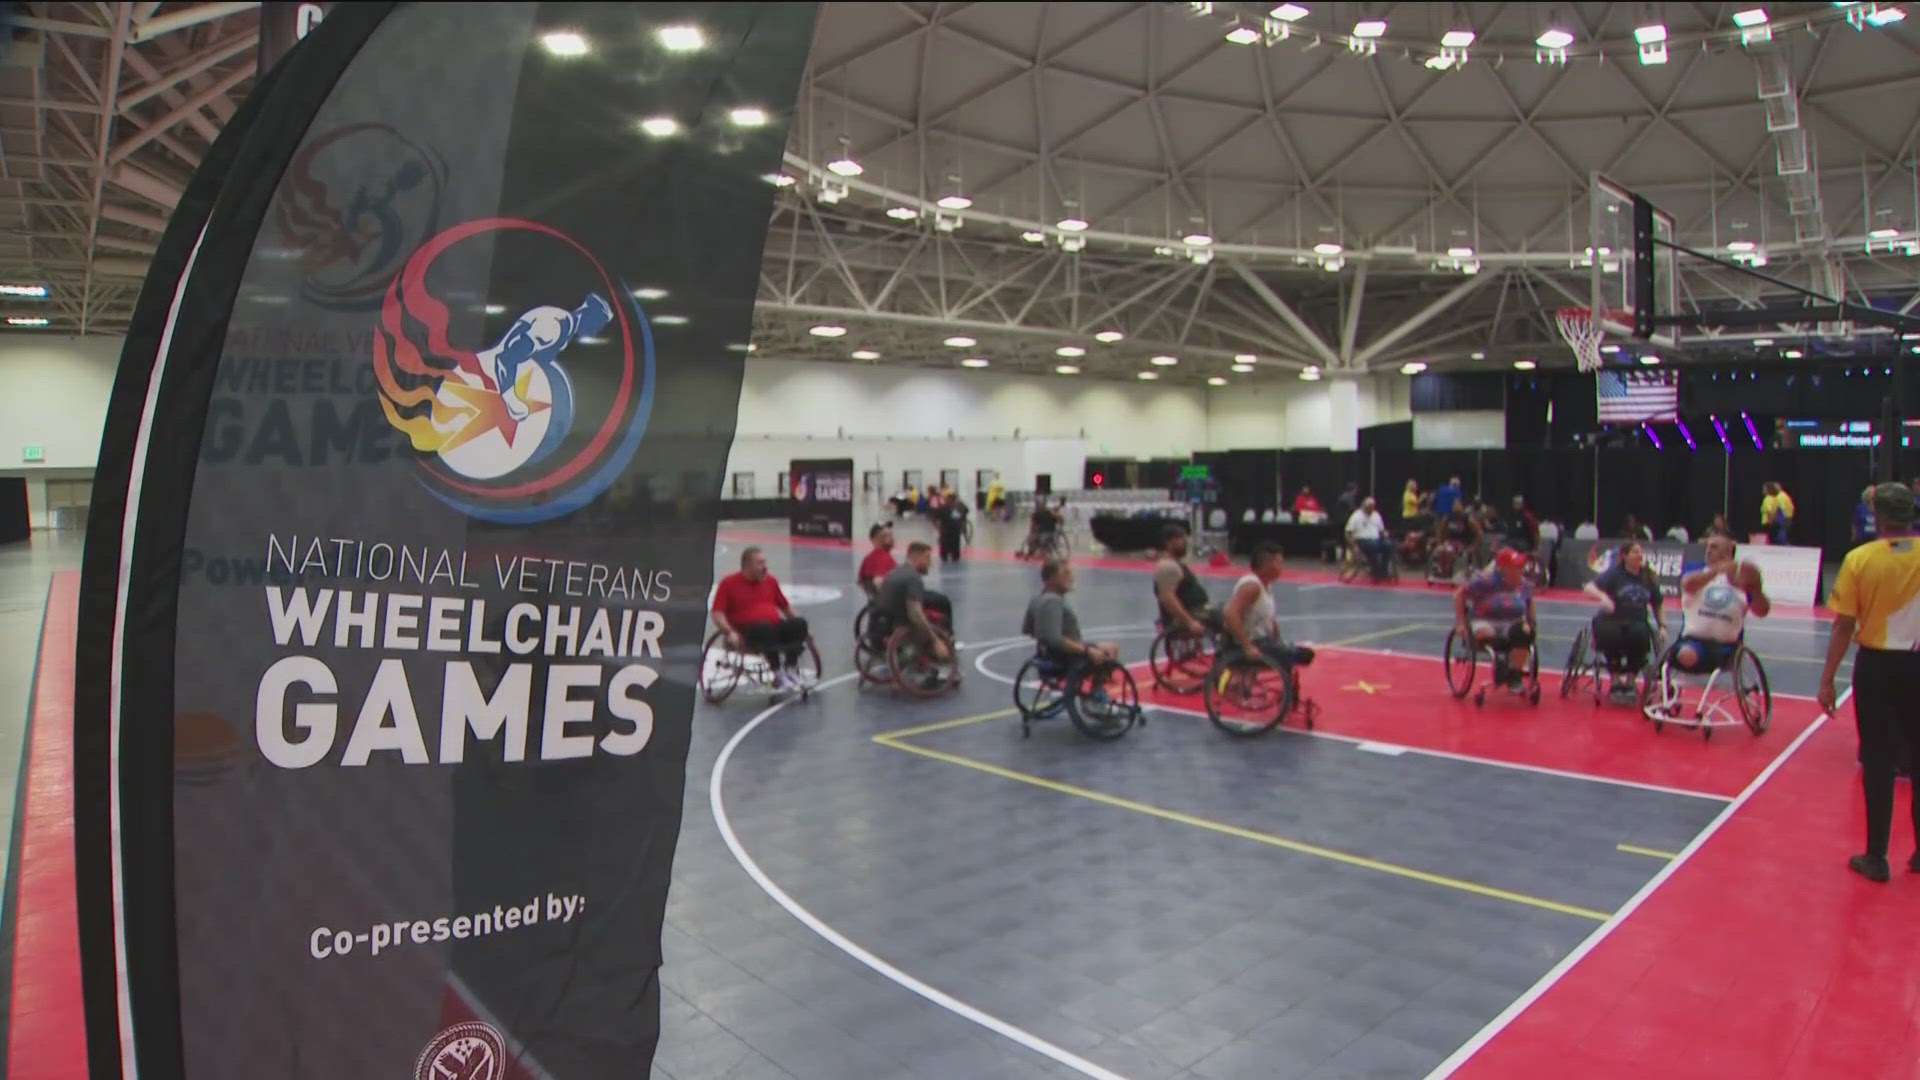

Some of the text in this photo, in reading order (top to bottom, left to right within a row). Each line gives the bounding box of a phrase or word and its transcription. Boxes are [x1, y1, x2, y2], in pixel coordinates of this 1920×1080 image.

[266, 533, 479, 588] NATIONAL
[494, 553, 672, 602] VETERANS
[265, 586, 665, 658] WHEELCHAIR
[255, 655, 660, 769] GAMES
[310, 897, 540, 959] Co-presented
